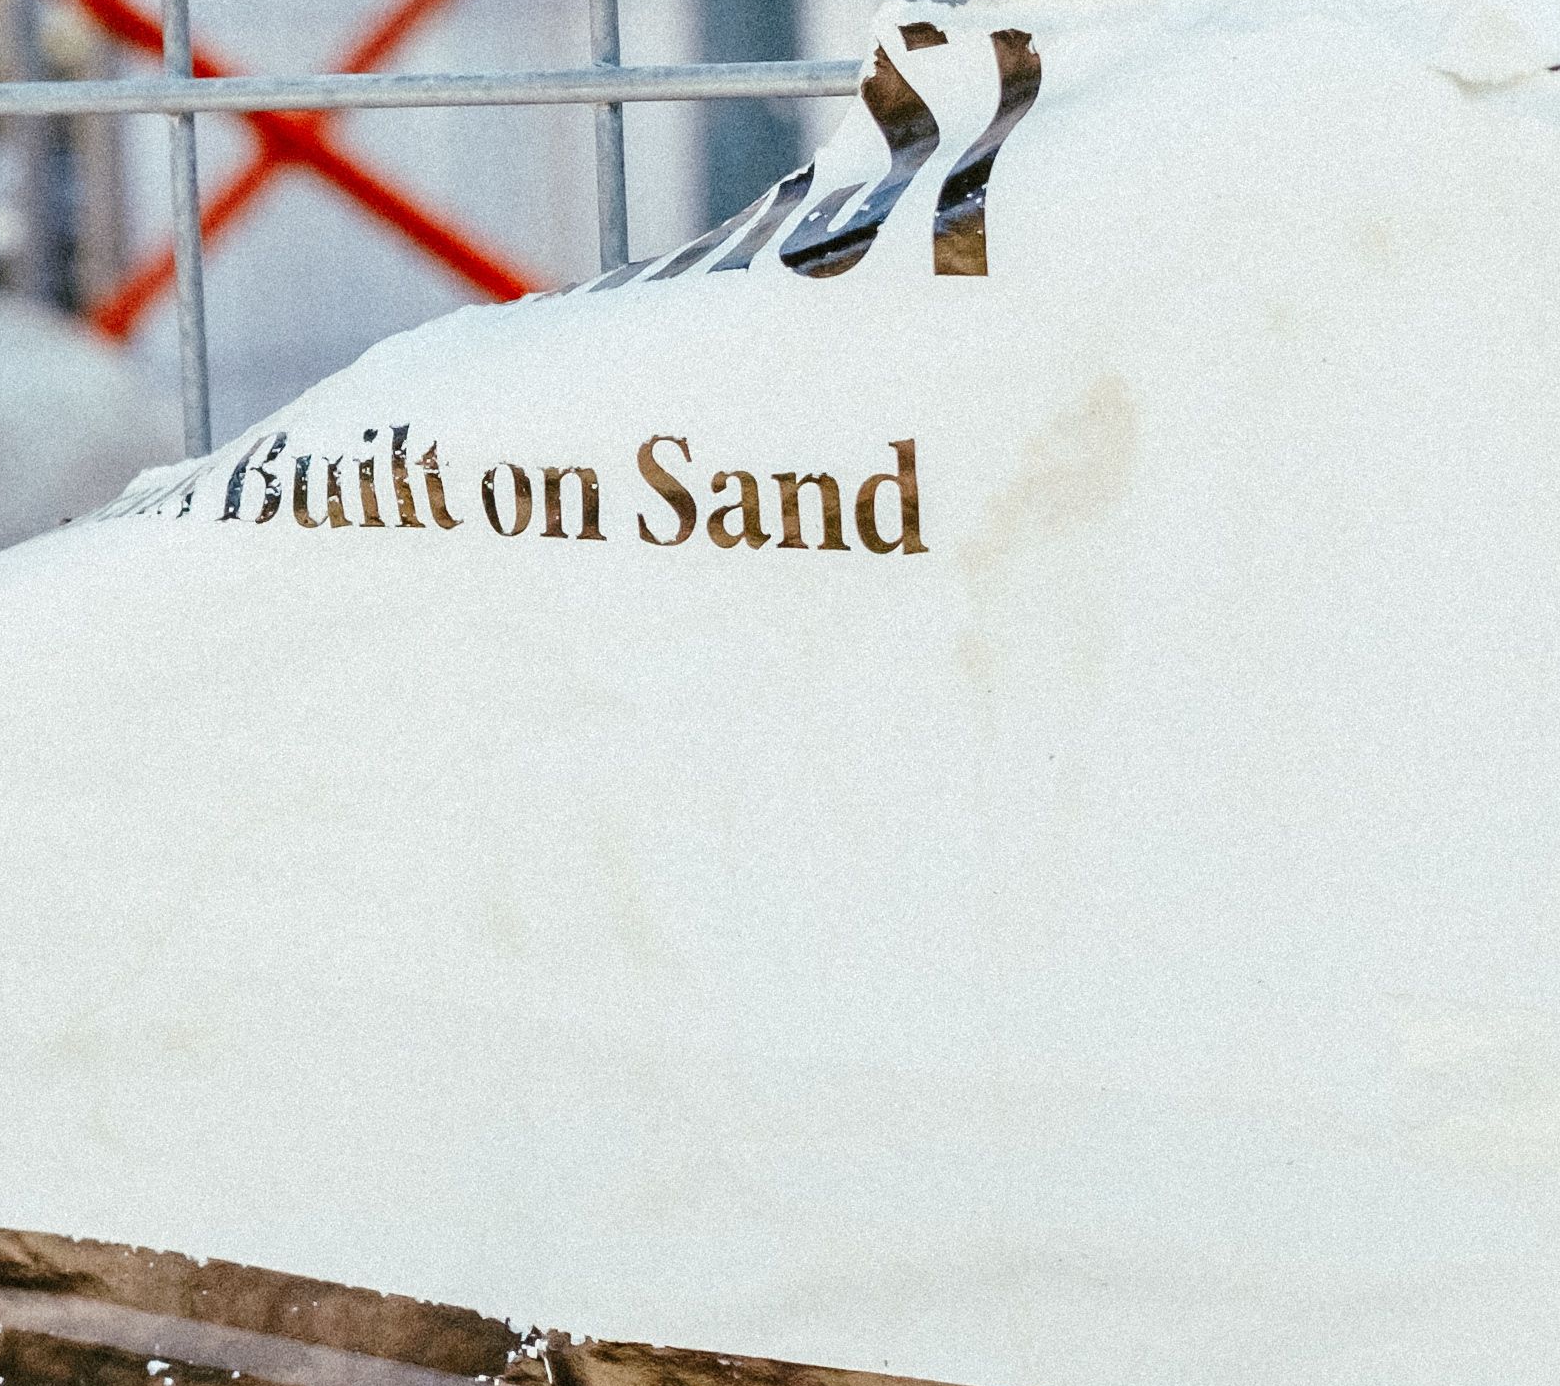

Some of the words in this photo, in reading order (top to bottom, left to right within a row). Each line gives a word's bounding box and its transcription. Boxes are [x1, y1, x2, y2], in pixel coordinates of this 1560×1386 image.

[215, 423, 463, 530] Built
[481, 462, 608, 542] on
[636, 434, 930, 555] Sand
